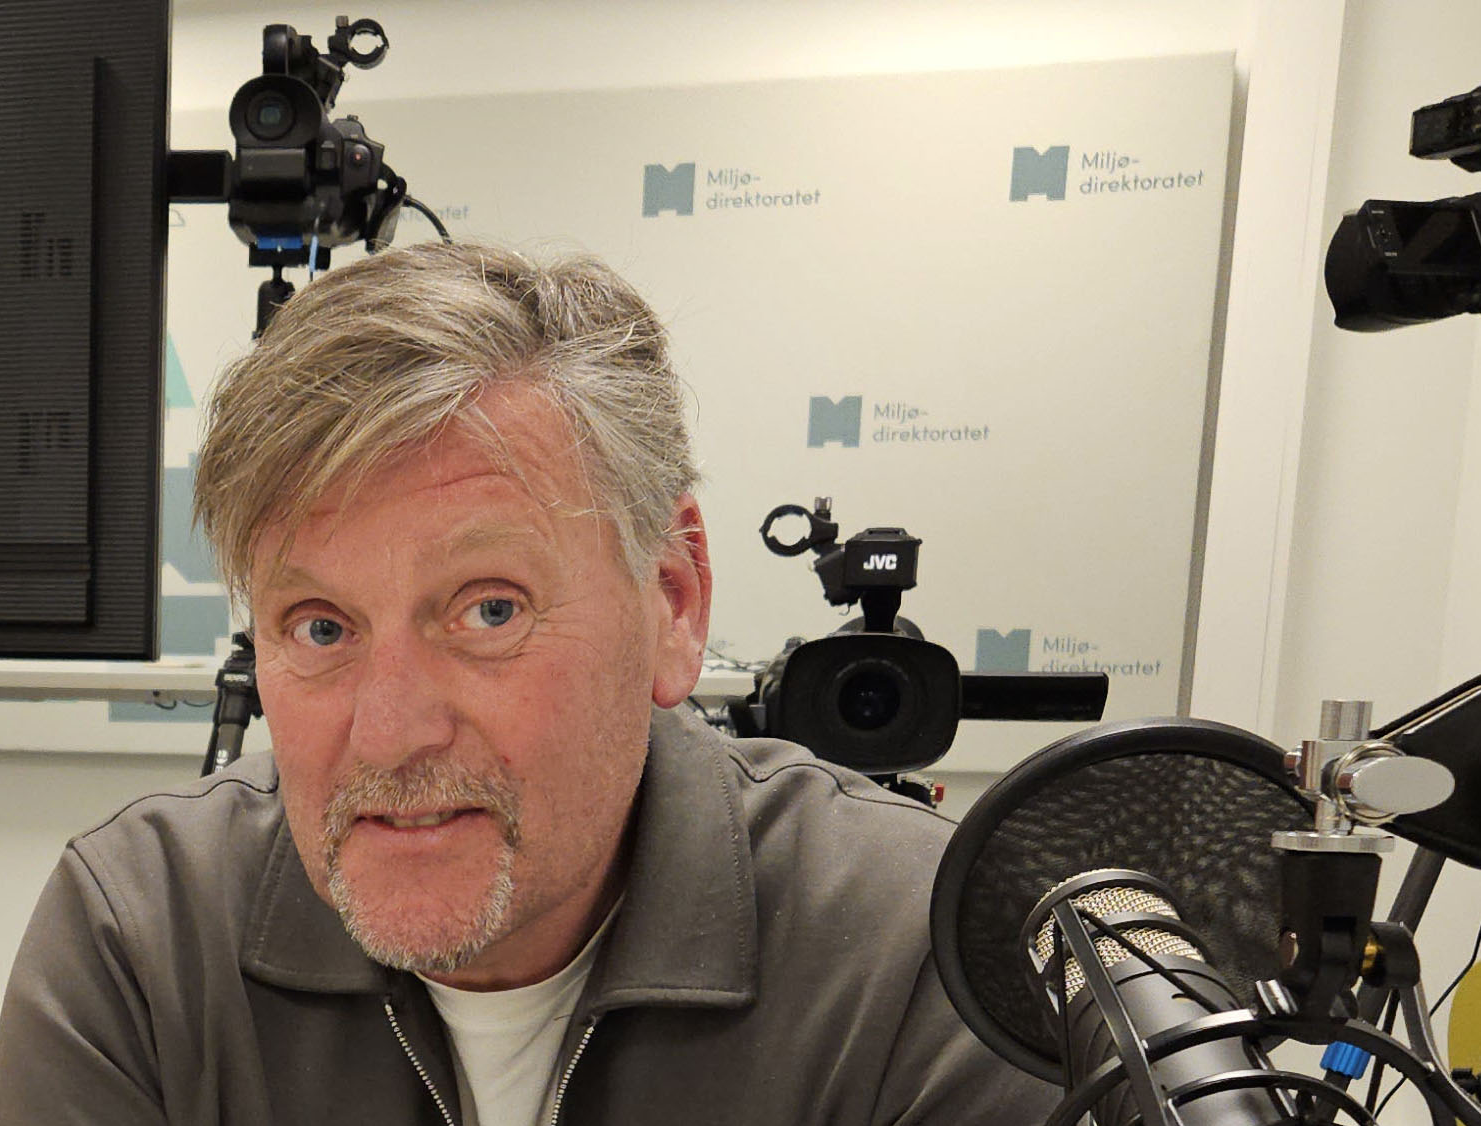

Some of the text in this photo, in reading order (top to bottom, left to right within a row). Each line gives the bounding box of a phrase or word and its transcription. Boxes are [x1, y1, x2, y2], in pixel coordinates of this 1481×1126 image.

[1081, 151, 1141, 174] Miljø-
[706, 167, 761, 190] Miljø-
[1079, 169, 1205, 195] direktoratet
[706, 189, 821, 210] direktoratet
[873, 402, 929, 424] Miljø-
[872, 425, 990, 443] direktoratet
[863, 553, 897, 570] JVC
[1042, 635, 1099, 657] Miljø-
[1041, 659, 1161, 676] direktoratet
